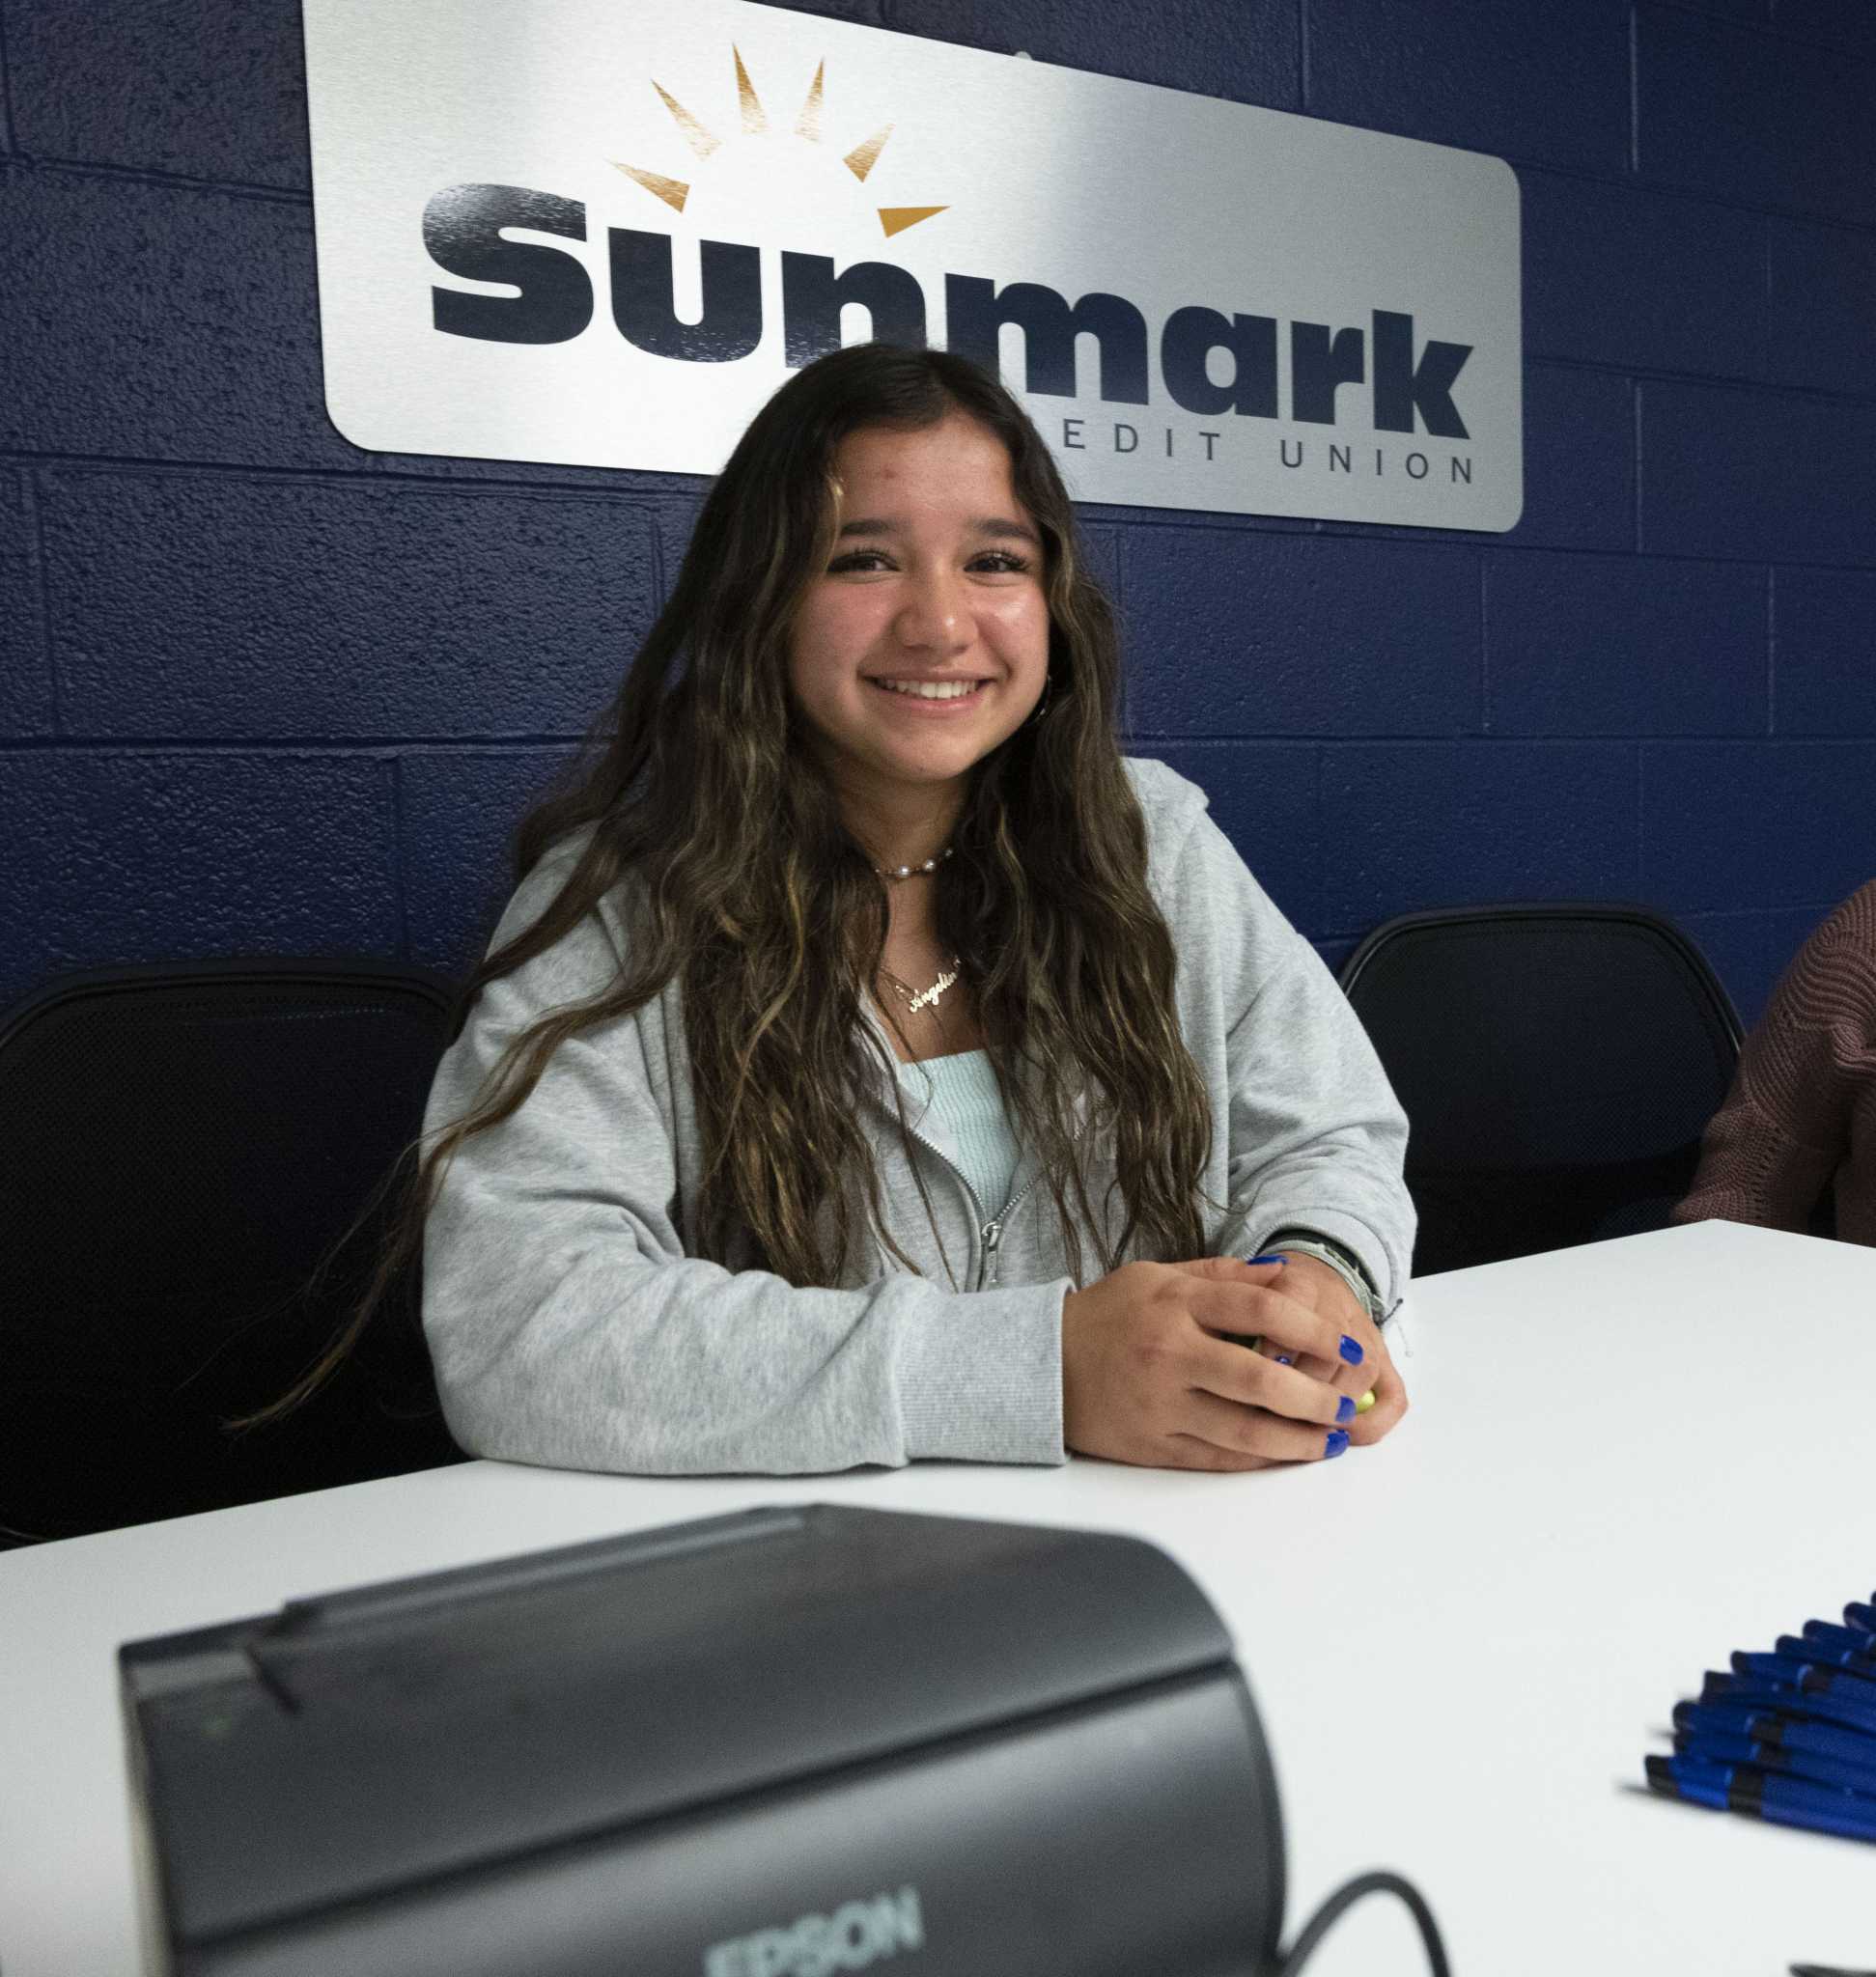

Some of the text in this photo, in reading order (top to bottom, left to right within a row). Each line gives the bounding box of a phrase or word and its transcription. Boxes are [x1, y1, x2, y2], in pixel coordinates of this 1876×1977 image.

[422, 182, 1474, 439] Sunmark
[1063, 418, 1473, 484] EDIT UNION
